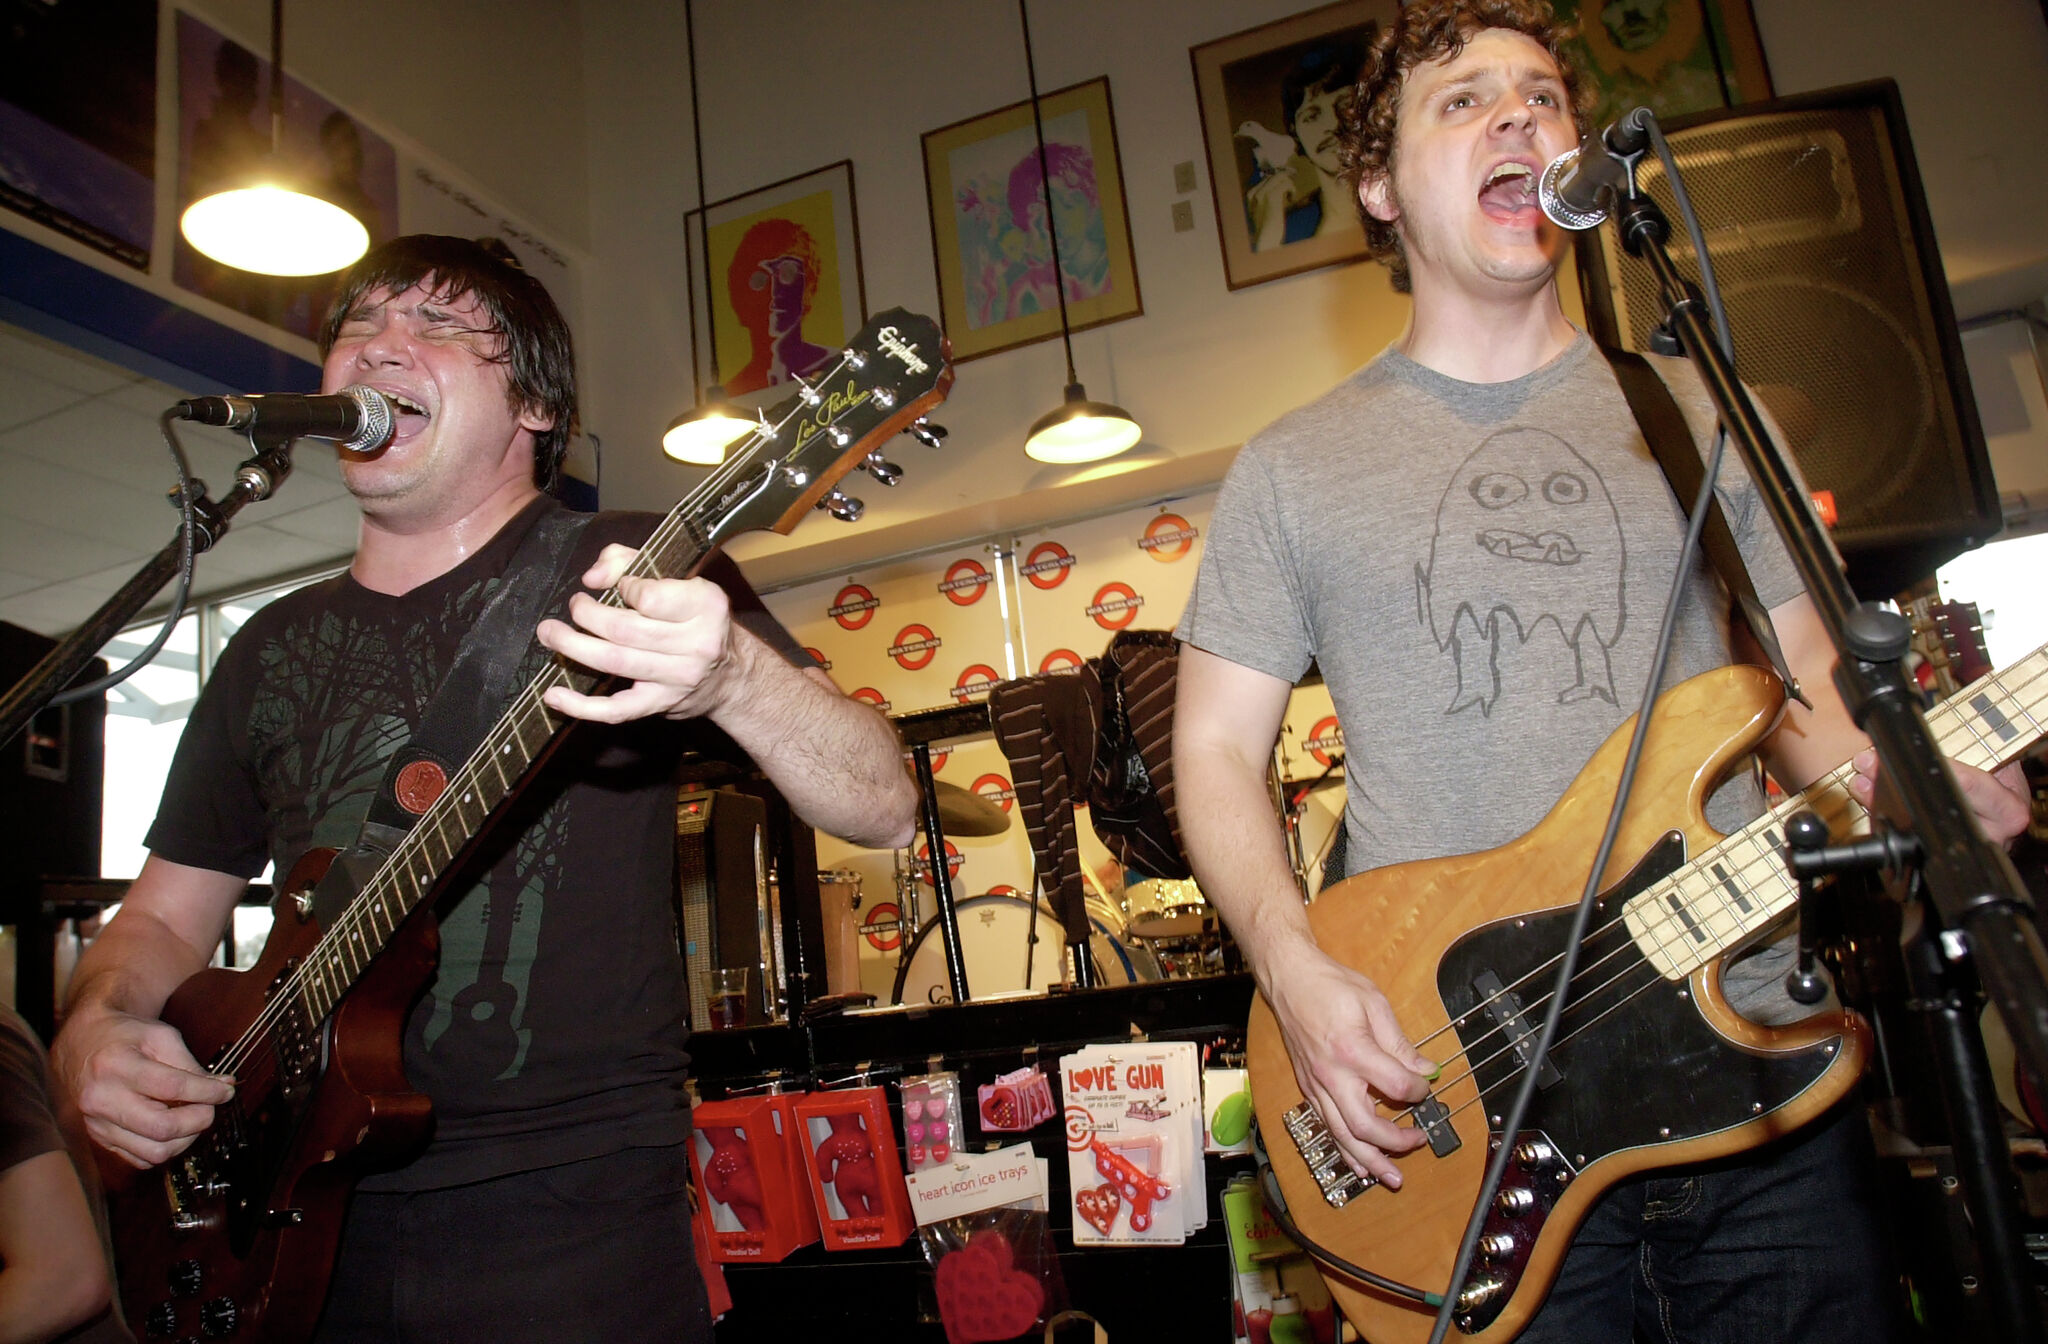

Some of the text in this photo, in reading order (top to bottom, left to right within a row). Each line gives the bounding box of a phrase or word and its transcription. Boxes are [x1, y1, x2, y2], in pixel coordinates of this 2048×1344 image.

[878, 326, 928, 376] Epiphone
[786, 380, 855, 462] Les Paul
[1138, 528, 1198, 549] WATERLOO
[1021, 556, 1076, 576] WATERLOO
[939, 573, 993, 592] WATERLOO
[828, 599, 880, 617] WATERLOO
[1086, 597, 1144, 617] WATERLOO
[888, 638, 942, 657] WATERLOO
[1126, 1063, 1164, 1090] GUN
[918, 1184, 949, 1202] heart
[951, 1178, 976, 1195] icon
[978, 1172, 997, 1187] ice
[999, 1164, 1028, 1181] trays
